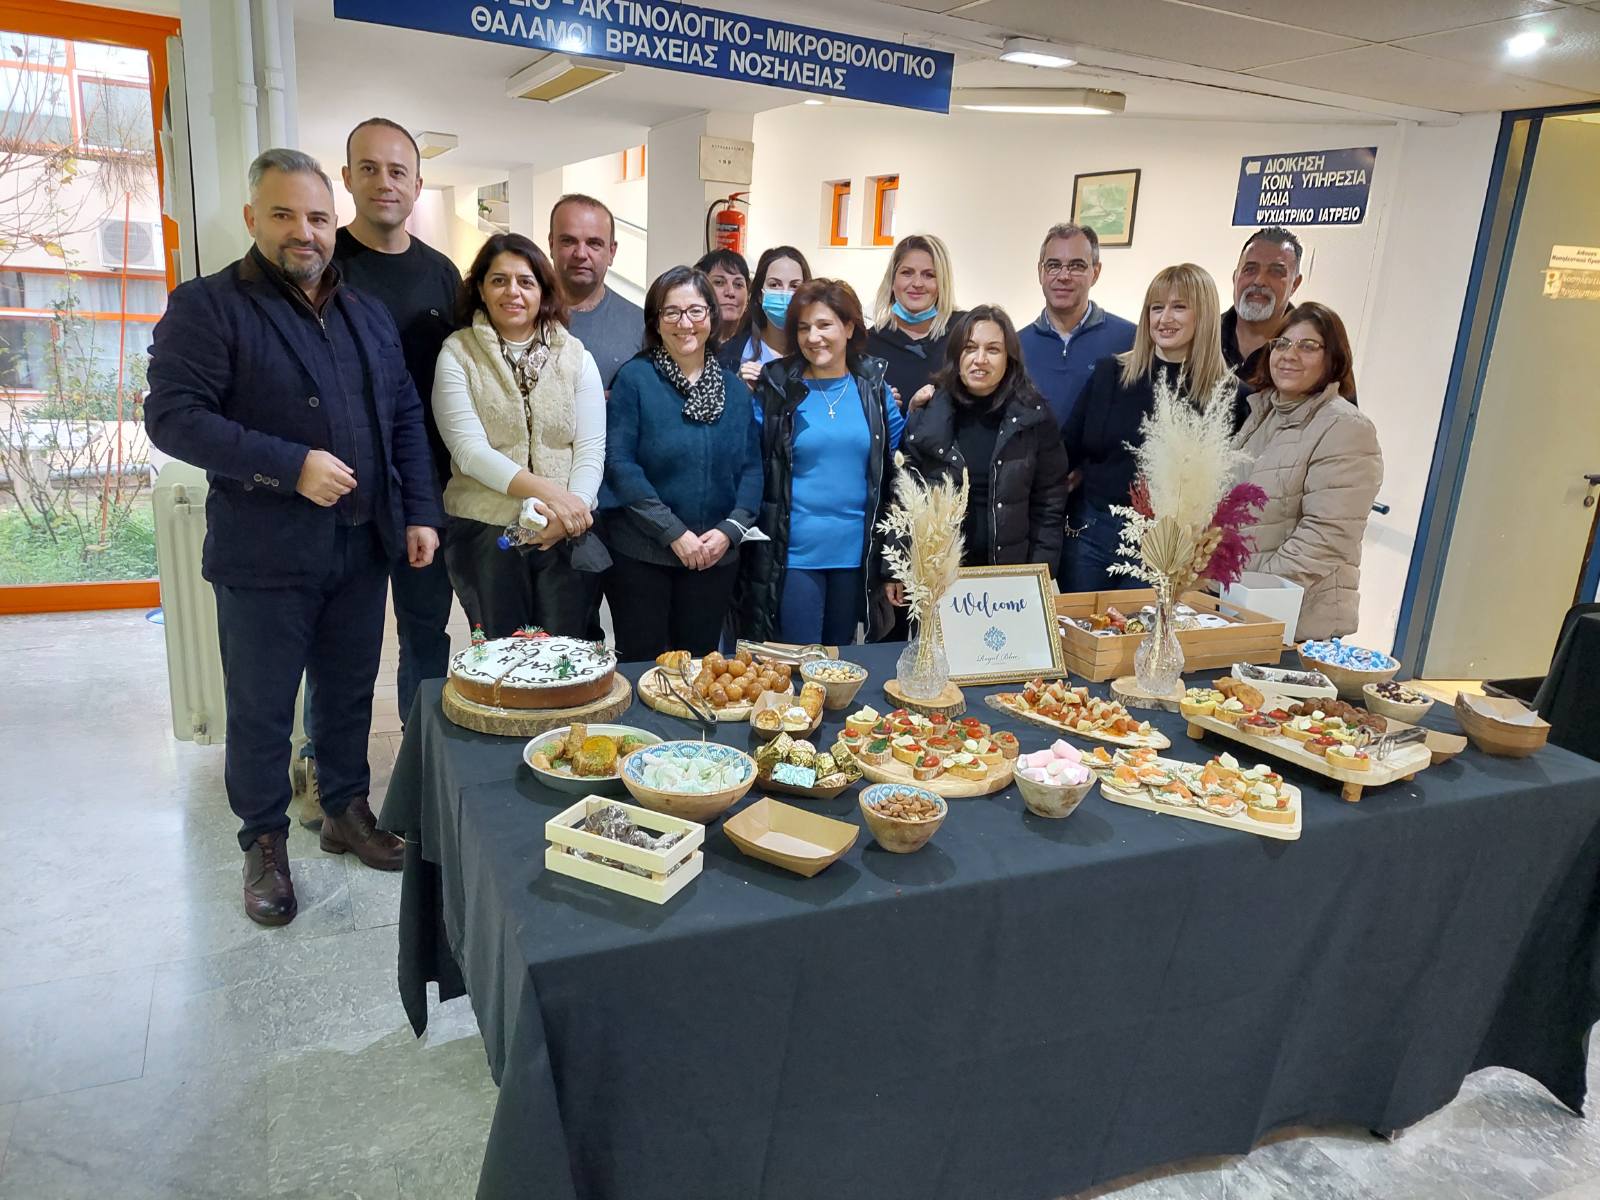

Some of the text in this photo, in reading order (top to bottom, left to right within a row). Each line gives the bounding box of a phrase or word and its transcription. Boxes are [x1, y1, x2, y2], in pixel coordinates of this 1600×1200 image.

[470, 5, 847, 91] ΘΑΛΑΜΟΙ ΒΡΑΧΕΙΑΣ ΝΟΣΗΛΕΙΑΣ
[1264, 154, 1326, 174] ΔΙΟΙΚΗΣΗ
[1261, 169, 1367, 190] ΚΟΙΝ. ΥΠΗΡΕΣΙΑ
[1259, 191, 1290, 207] ΜΑΙΑ
[1256, 206, 1361, 224] ΨΥΧΙΑΤΡΙΚΟ ΙΑΤΡΕΙΟ
[950, 591, 1028, 618] Welcome
